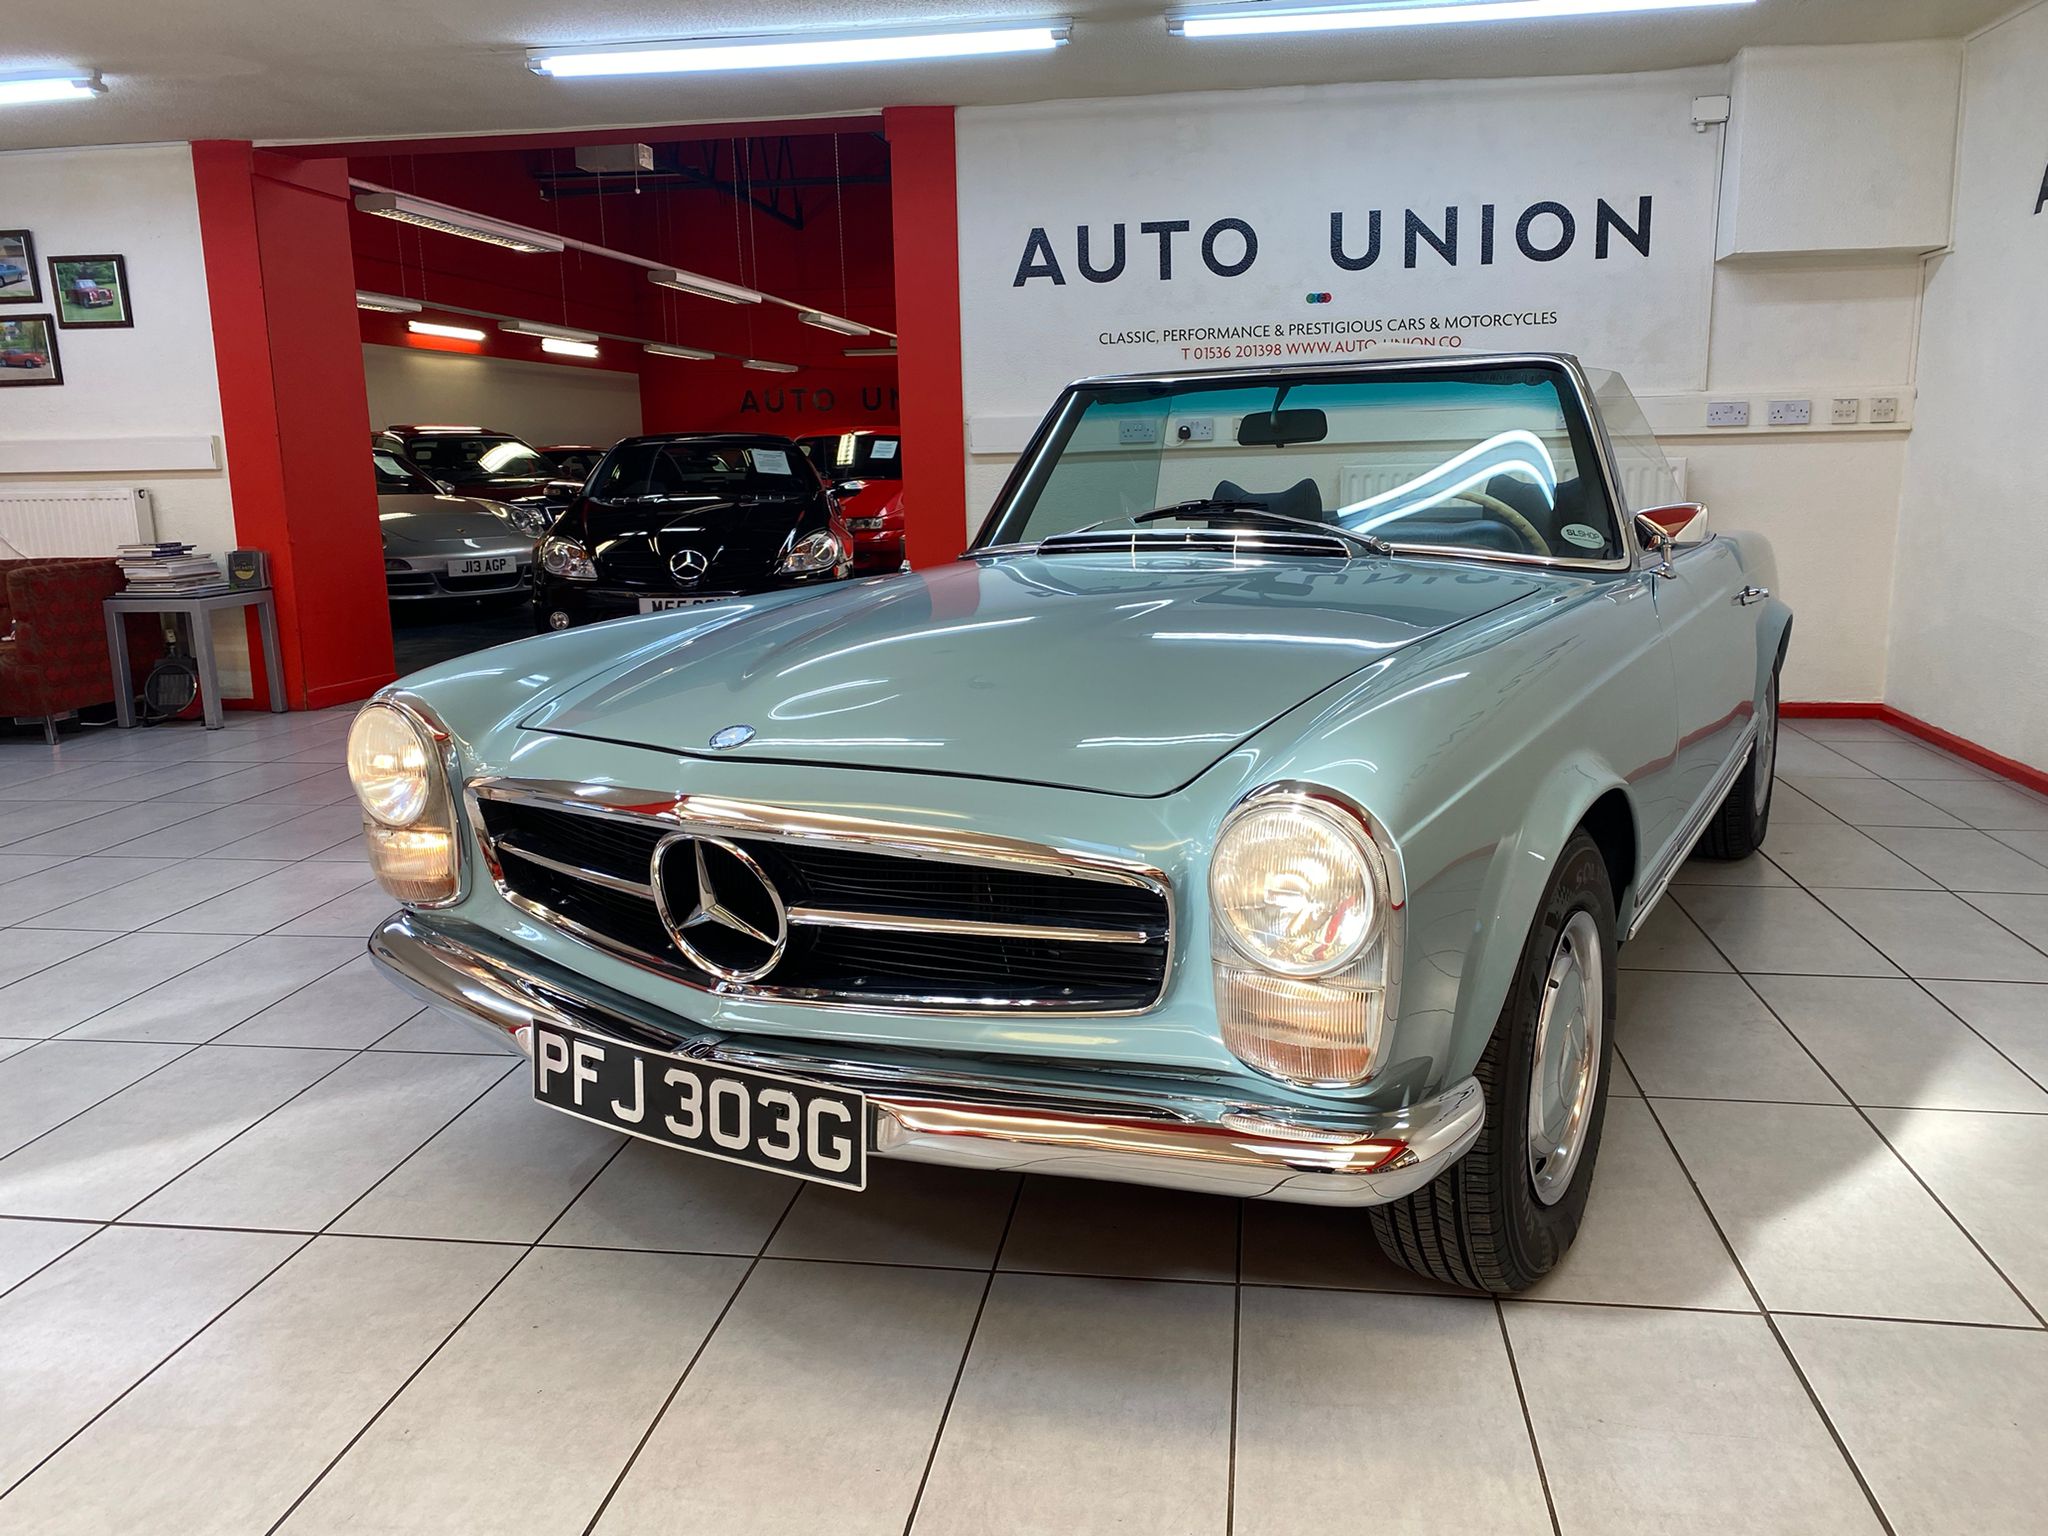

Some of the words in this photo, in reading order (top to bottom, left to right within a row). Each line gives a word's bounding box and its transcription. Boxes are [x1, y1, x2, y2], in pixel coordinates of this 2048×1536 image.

[1012, 217, 1260, 288] AUTO
[1329, 195, 1653, 272] UNION
[1099, 330, 1160, 345] CLASSIC,
[1163, 324, 1271, 343] PERFORMANCE
[1274, 324, 1285, 337] &
[1288, 318, 1383, 336] PRESTIGIOUS
[1387, 317, 1426, 332] CARS
[1430, 317, 1440, 330] &
[1444, 310, 1558, 329] MOTORCYCLES
[1181, 347, 1190, 360] T
[1193, 346, 1231, 360] 01536
[1235, 343, 1282, 359] 201398
[739, 387, 836, 414] AUTO
[461, 560, 481, 574] J13
[484, 558, 507, 572] AGP
[538, 1029, 645, 1124] PFJ
[663, 1067, 852, 1173] 303G
